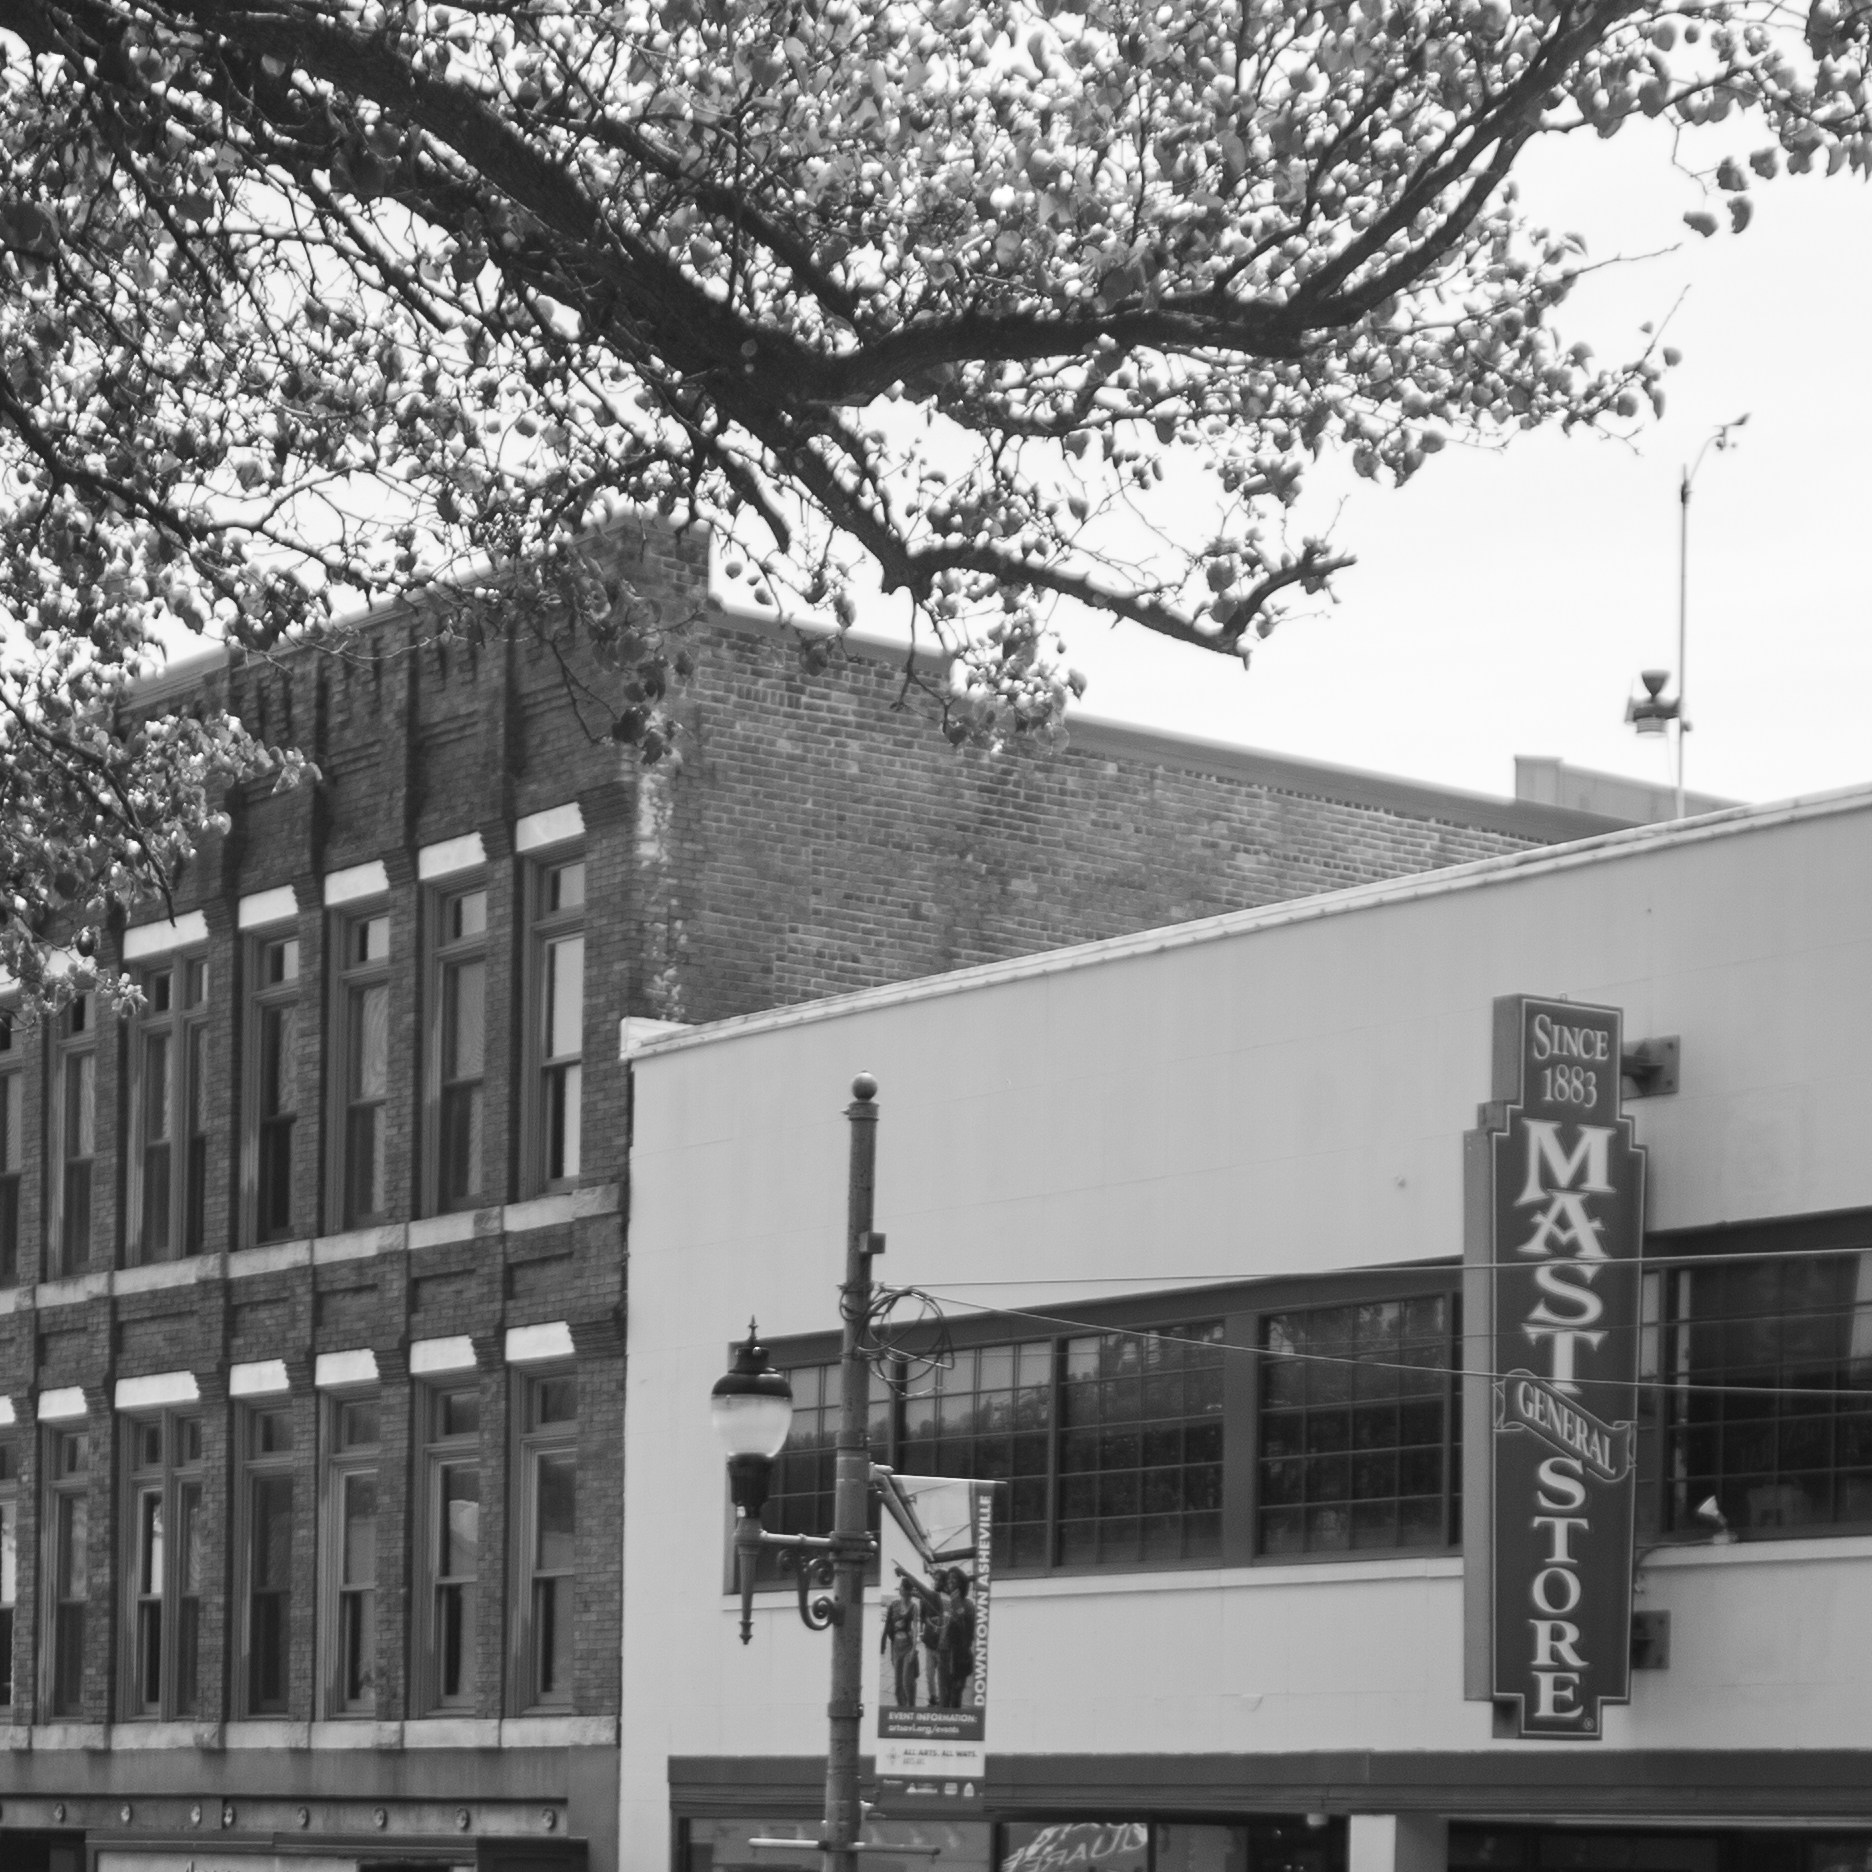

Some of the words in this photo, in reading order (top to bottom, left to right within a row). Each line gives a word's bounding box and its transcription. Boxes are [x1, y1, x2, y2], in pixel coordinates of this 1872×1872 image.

[1533, 1013, 1609, 1060] SINCE
[1542, 1063, 1598, 1108] 1883
[1513, 1117, 1617, 1394] MAST
[1517, 1380, 1617, 1477] GENERAL
[978, 1494, 992, 1587] ASHEVILLE
[1528, 1456, 1589, 1718] STORE
[974, 1591, 989, 1706] DOWNTOWN
[888, 1711, 914, 1721] EVENT
[916, 1712, 978, 1723] INFORMATION:
[903, 1748, 916, 1756] ALL
